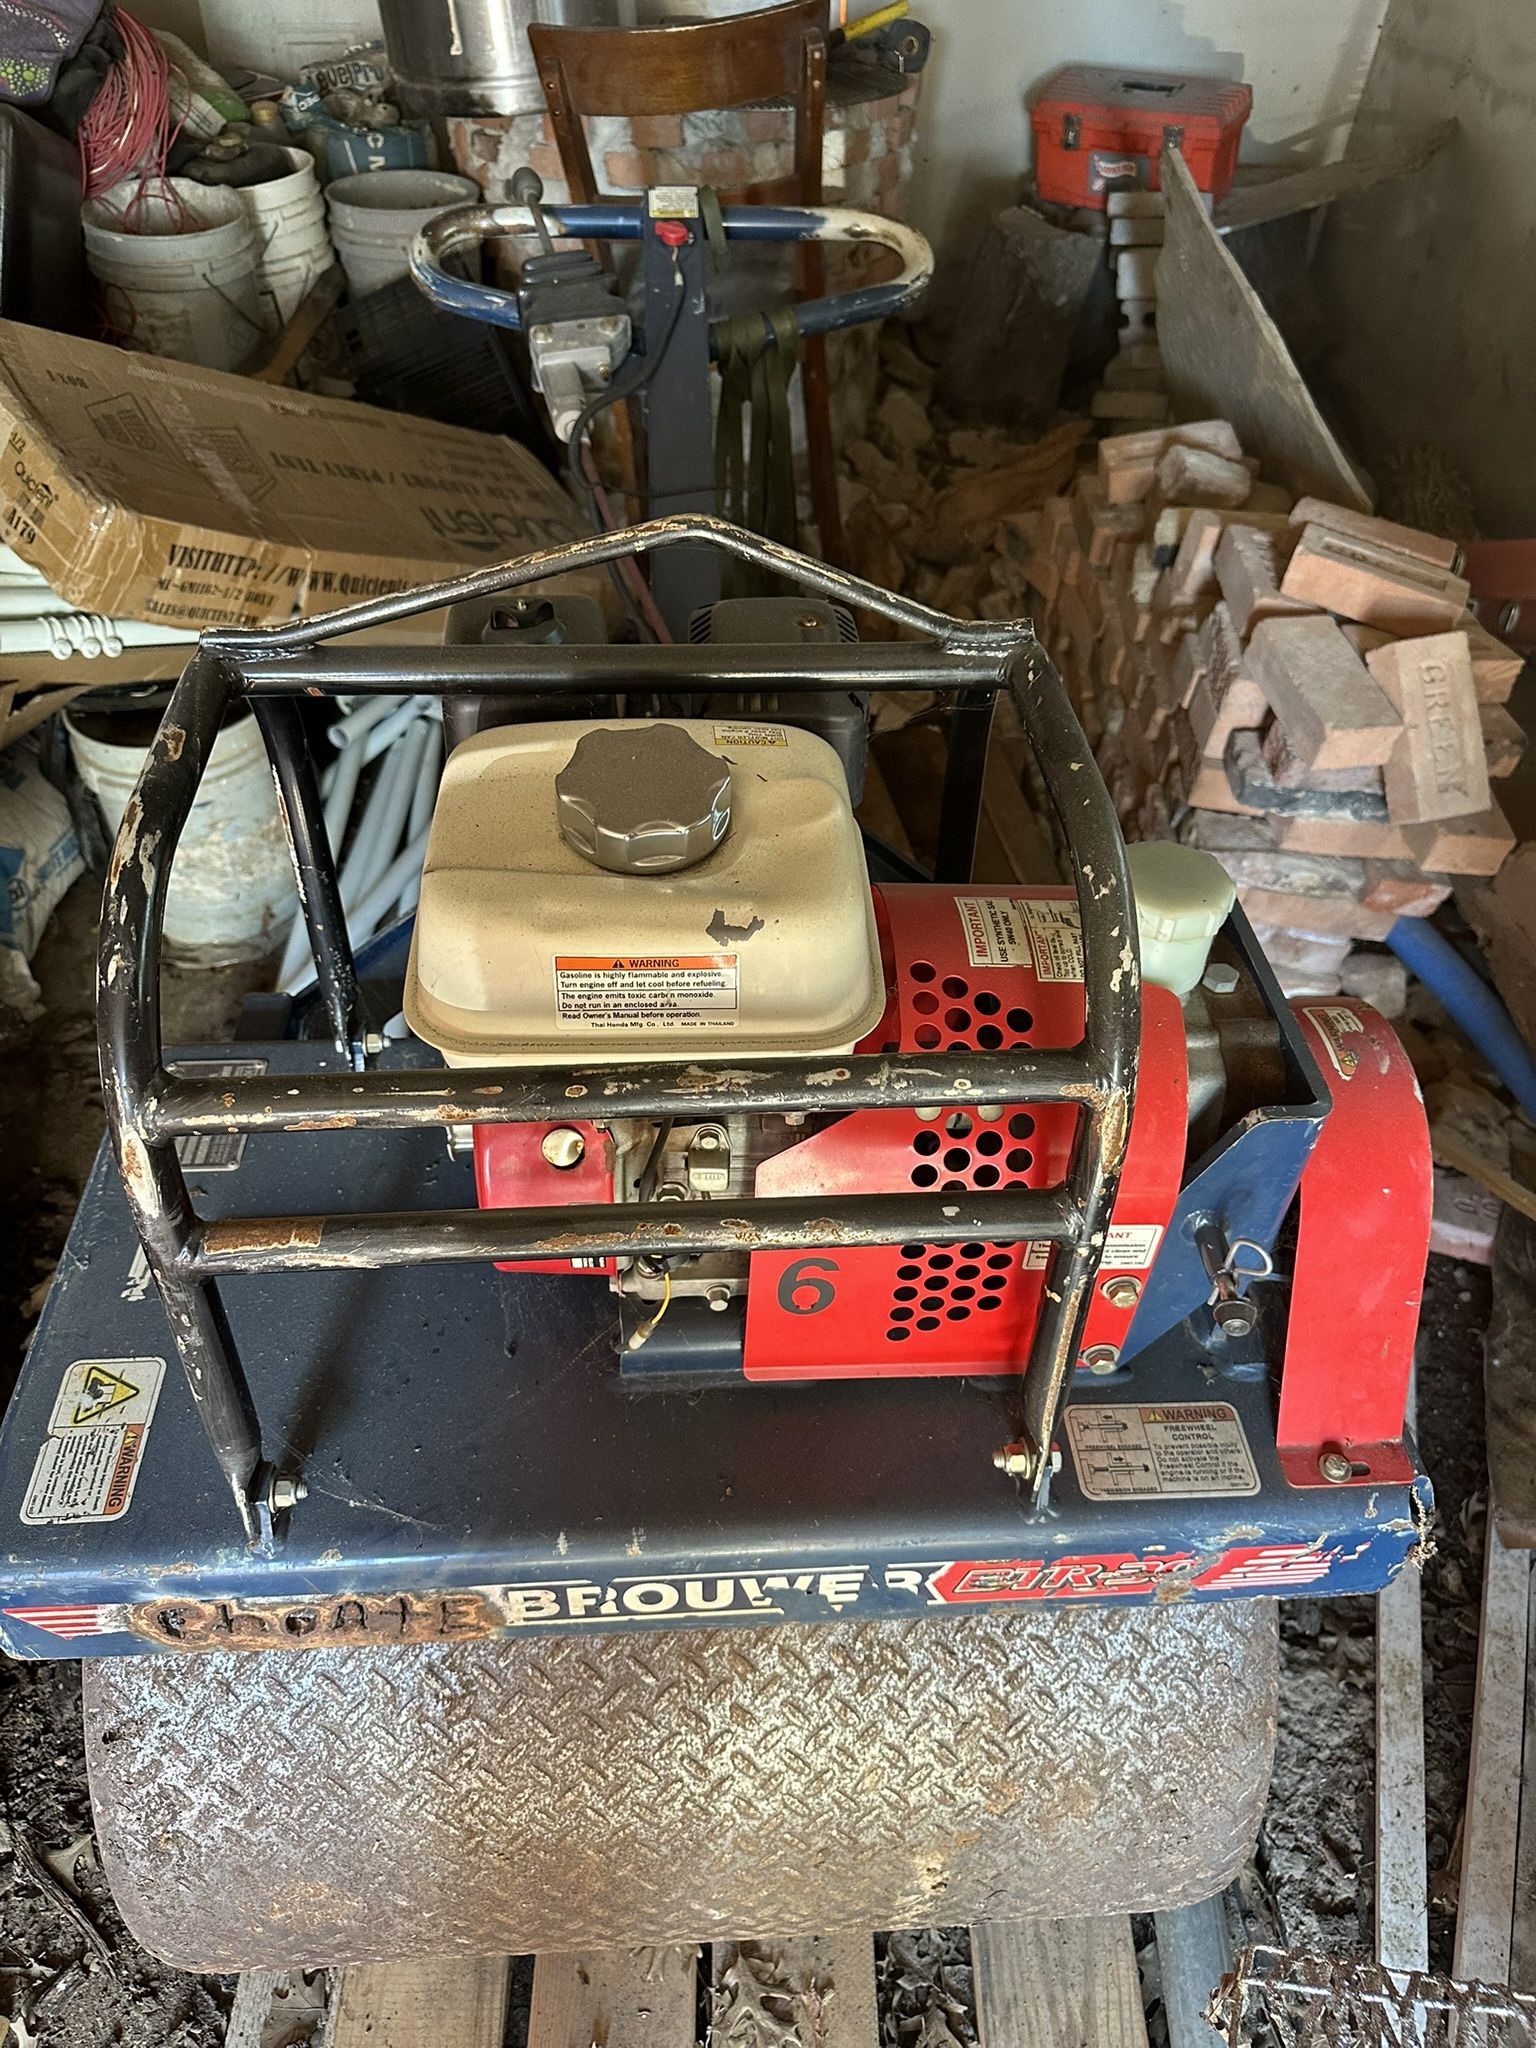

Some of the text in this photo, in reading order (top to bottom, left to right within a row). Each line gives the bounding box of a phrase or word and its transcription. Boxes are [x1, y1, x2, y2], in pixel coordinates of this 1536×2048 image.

[963, 901, 988, 958] IMPORTANT
[999, 947, 1009, 962] USE
[629, 959, 680, 968] WARNING
[559, 971, 592, 979] Gasoline
[602, 971, 626, 980] highly
[579, 981, 605, 989] engine
[666, 980, 691, 988] before
[561, 992, 575, 1000] The
[778, 1257, 840, 1315] 6
[1162, 1408, 1227, 1420] WARNING
[1163, 1424, 1217, 1432] FREEWHEEL
[1172, 1433, 1215, 1441] CONTROL
[108, 1444, 137, 1507] WARNING
